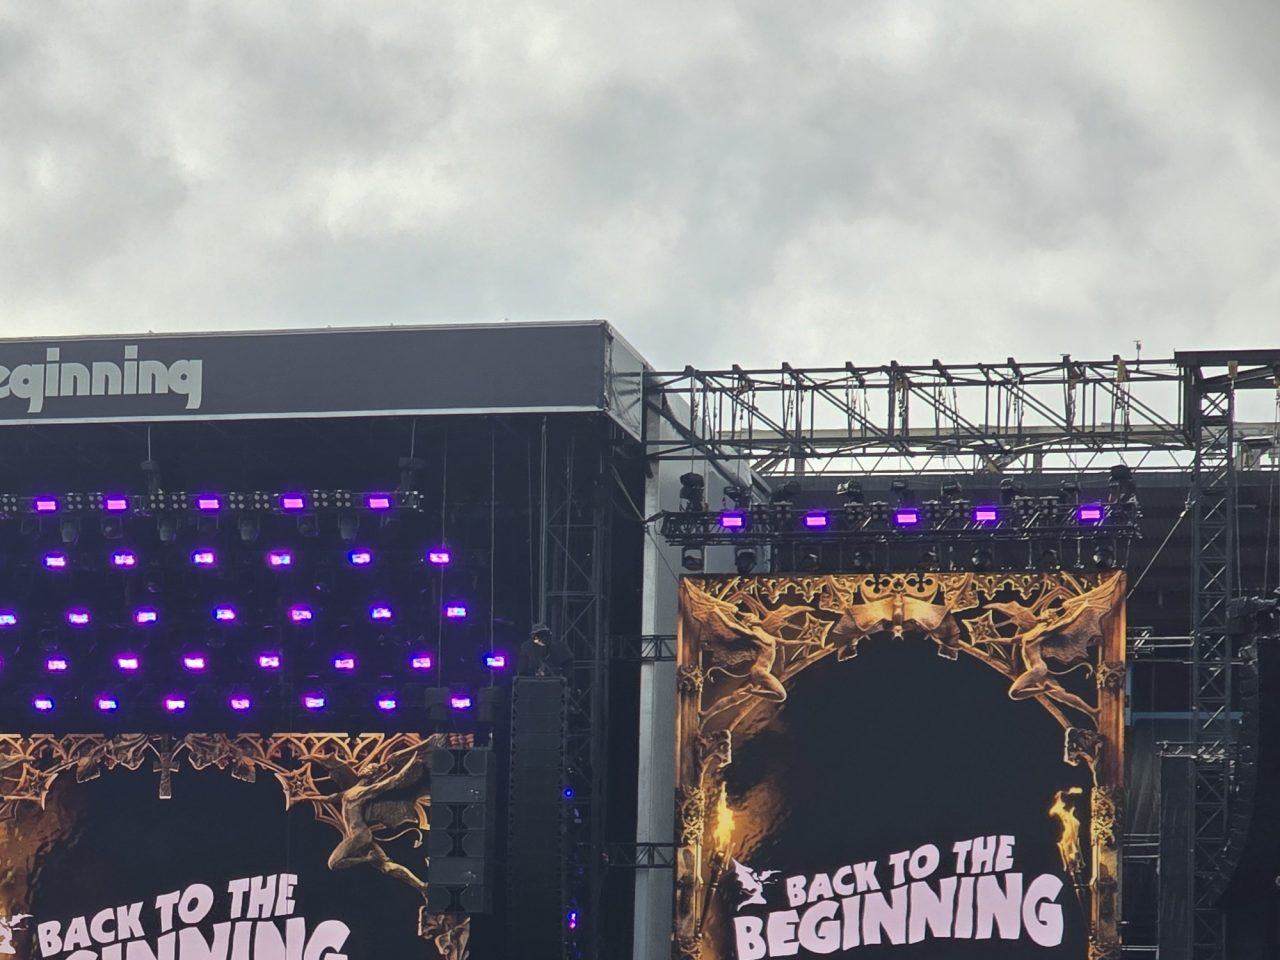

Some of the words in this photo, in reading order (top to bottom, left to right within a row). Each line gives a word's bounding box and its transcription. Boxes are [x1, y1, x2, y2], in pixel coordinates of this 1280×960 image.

[785, 860, 880, 907] BACK
[889, 844, 940, 887] TO
[952, 835, 1016, 874] THE
[37, 901, 146, 958] BACK
[155, 883, 214, 931] TO
[227, 873, 298, 919] THE
